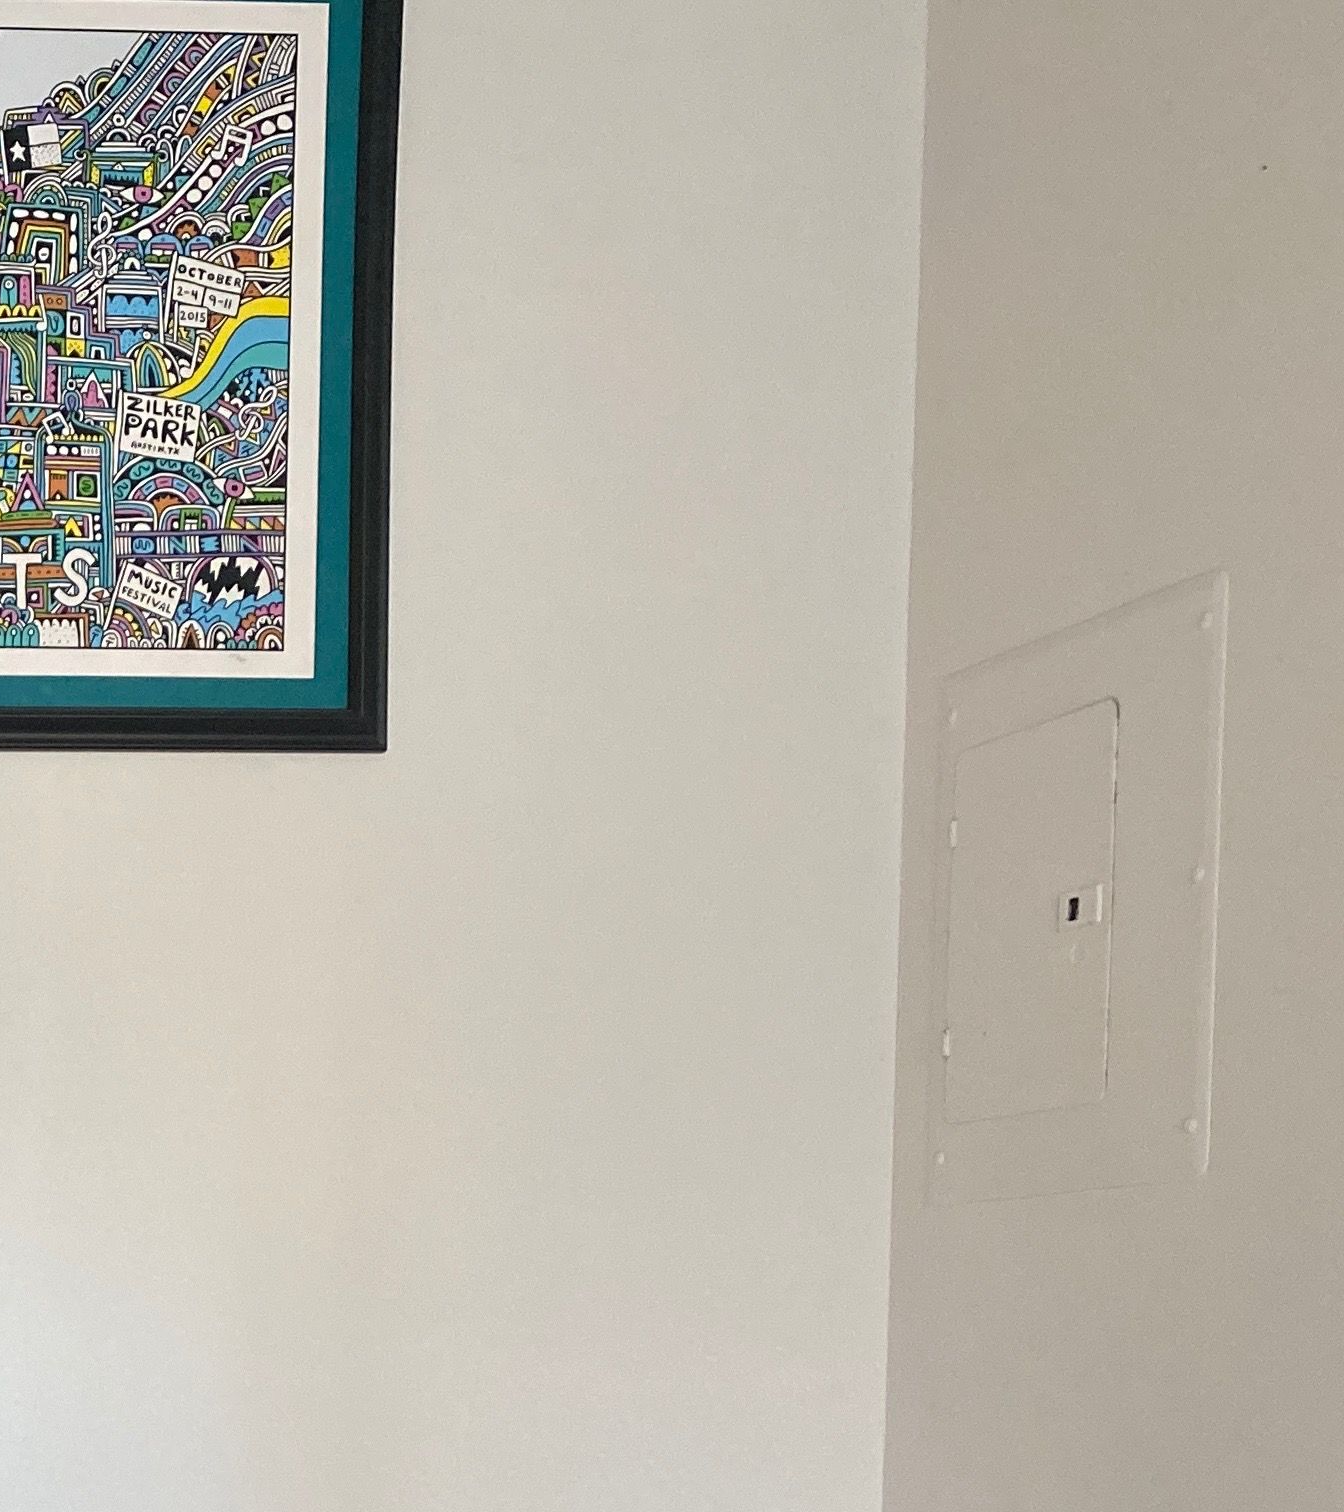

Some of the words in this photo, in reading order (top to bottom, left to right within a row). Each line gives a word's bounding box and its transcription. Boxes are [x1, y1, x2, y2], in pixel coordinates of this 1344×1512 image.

[177, 263, 243, 288] OCTOBER
[176, 286, 199, 301] 2-4
[208, 294, 232, 310] 9-11
[179, 310, 206, 323] 2015
[126, 395, 196, 421] ZILKER
[124, 412, 196, 447] PARK
[127, 569, 178, 599] MUSIC
[121, 586, 172, 614] FESTIVAL
